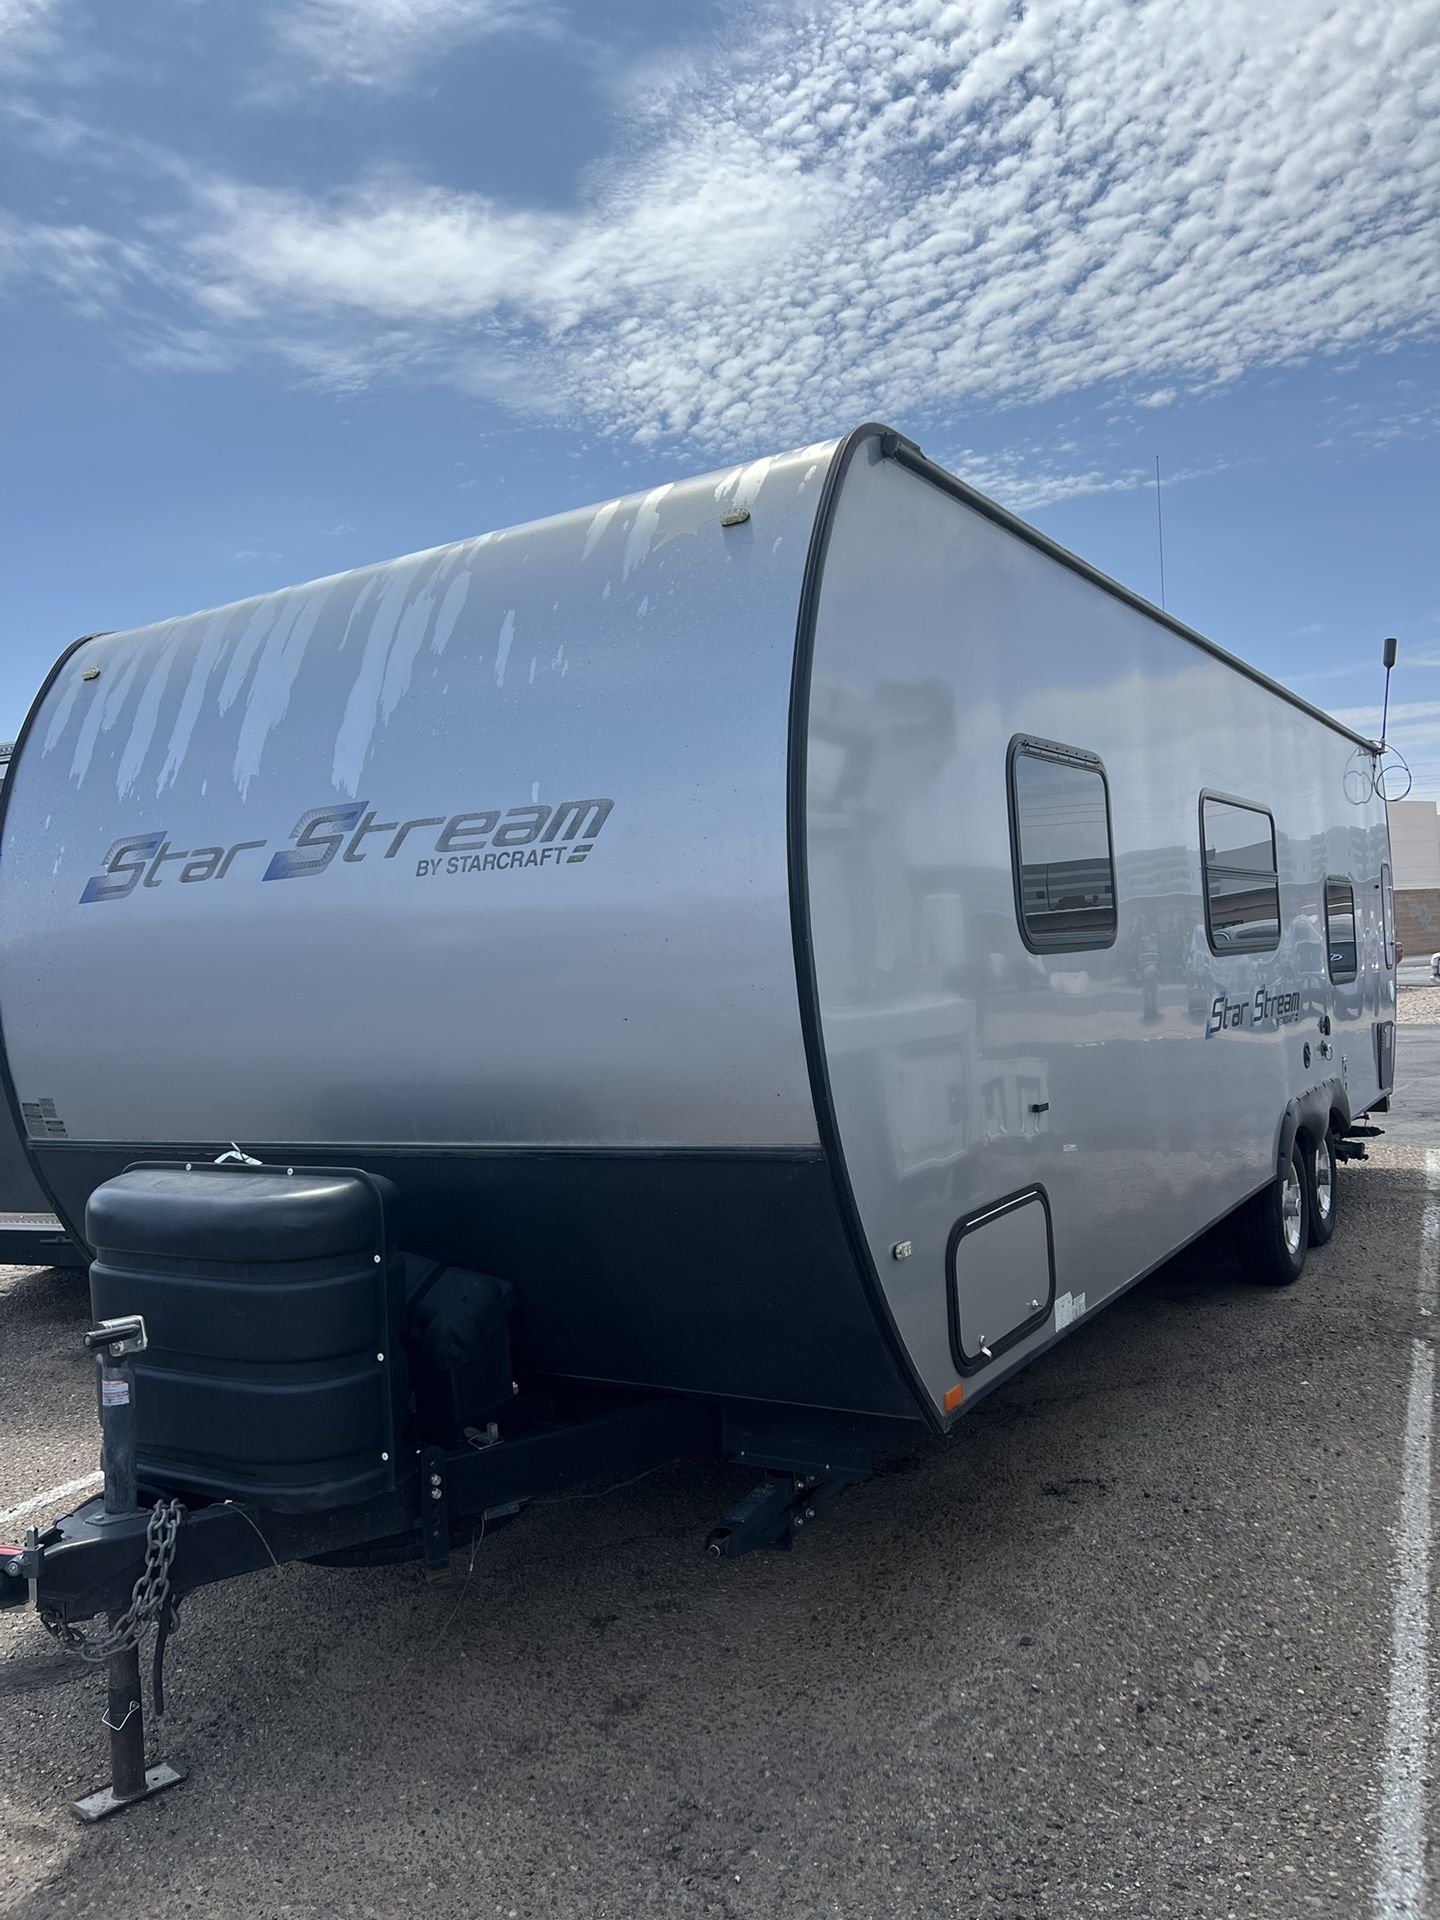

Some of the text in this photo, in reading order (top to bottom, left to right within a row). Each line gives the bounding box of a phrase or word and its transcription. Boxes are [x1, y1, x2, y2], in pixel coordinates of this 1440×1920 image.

[79, 797, 616, 905] Star Stream
[415, 846, 568, 878] BY STARCRAFT
[1206, 985, 1300, 1038] Star Stream
